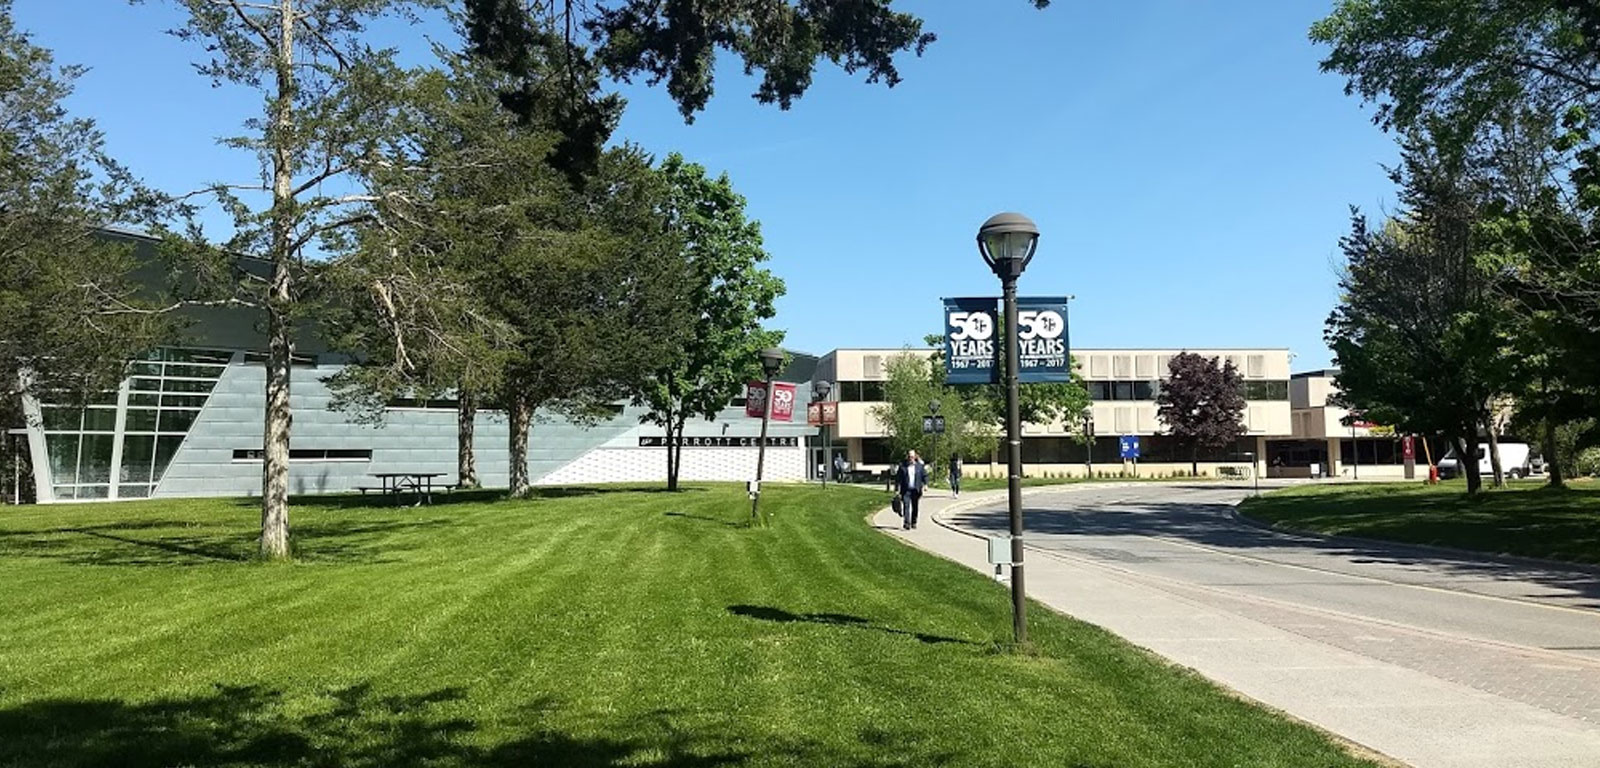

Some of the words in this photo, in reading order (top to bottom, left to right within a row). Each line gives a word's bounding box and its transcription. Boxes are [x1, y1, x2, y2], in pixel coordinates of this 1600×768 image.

[949, 311, 993, 340] 50
[1018, 310, 1064, 340] 50
[950, 341, 994, 356] YEARS
[1018, 339, 1065, 355] YEARS
[749, 387, 766, 400] 50
[775, 390, 792, 402] 50
[661, 437, 731, 446] PARROTT
[740, 437, 796, 446] CETRE
